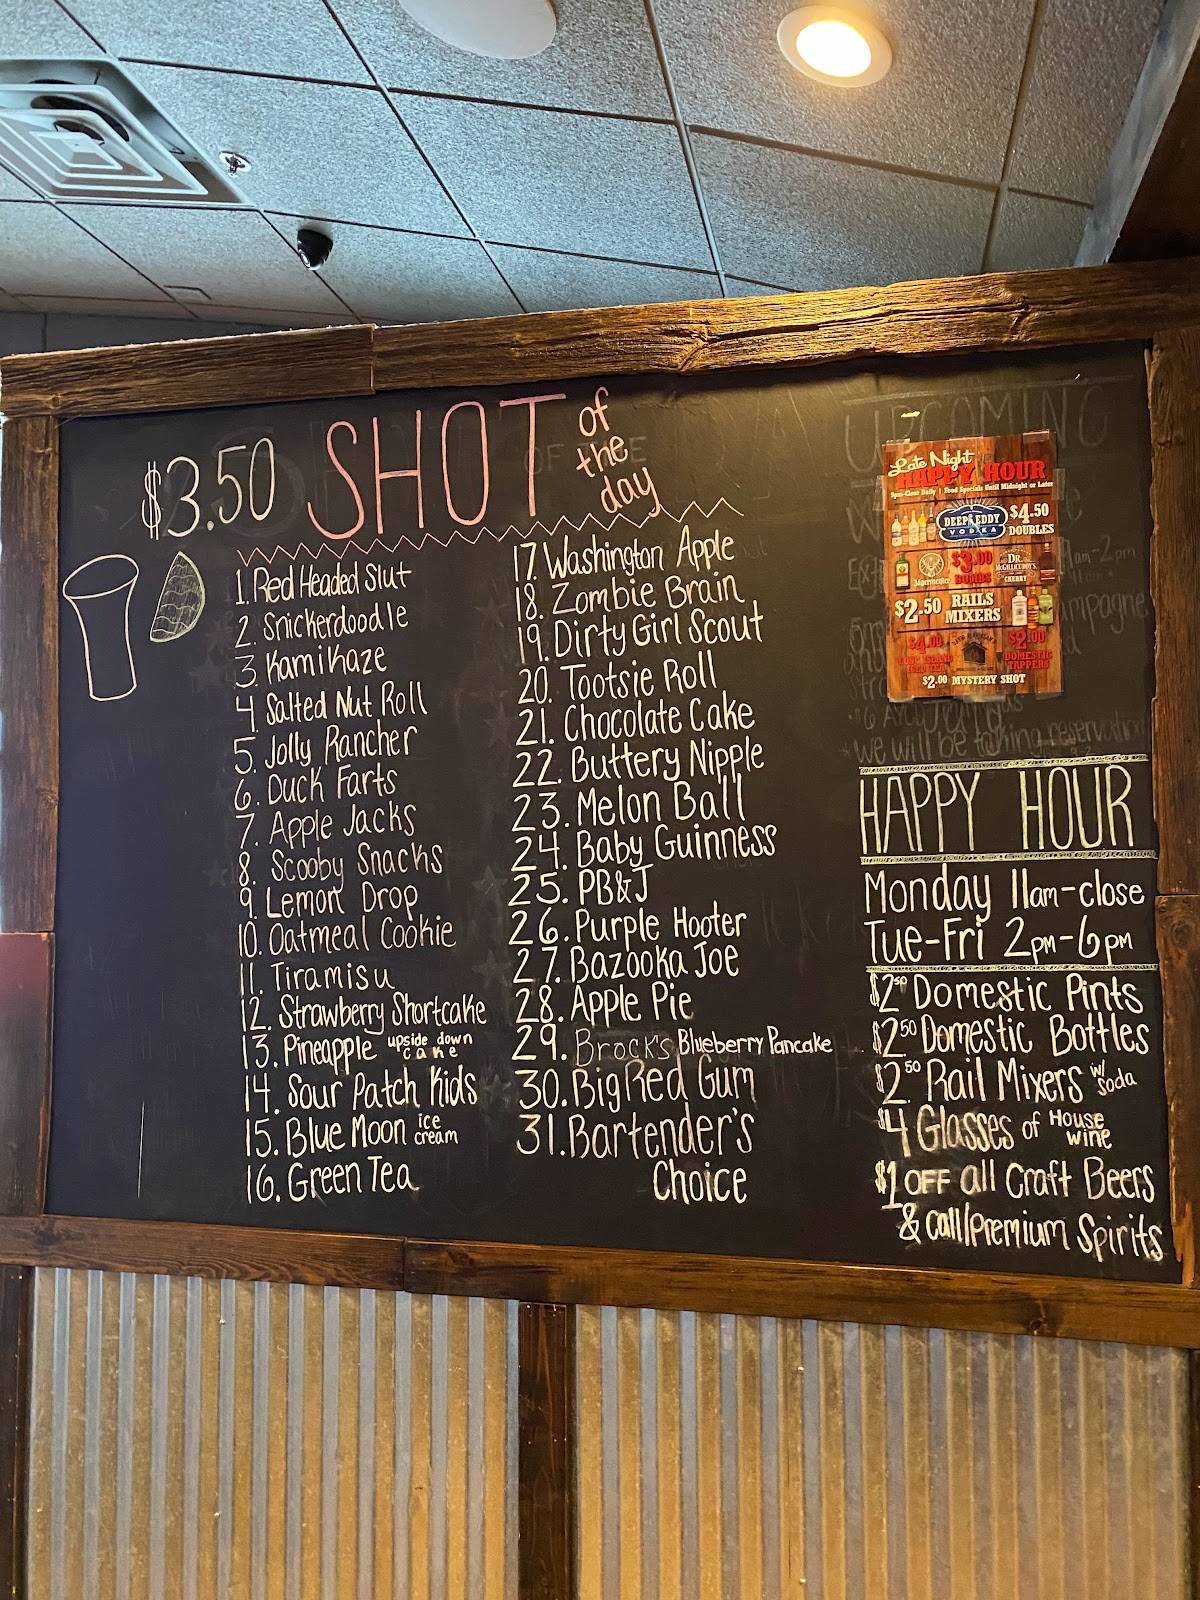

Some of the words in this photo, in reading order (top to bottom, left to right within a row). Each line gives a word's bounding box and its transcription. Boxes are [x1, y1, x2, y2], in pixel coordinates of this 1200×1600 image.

[579, 387, 610, 437] of
[142, 438, 274, 541] $3.50
[307, 393, 567, 540] SHOT
[576, 435, 628, 478] the
[888, 455, 929, 477] Late
[930, 450, 975, 471] Night
[897, 465, 975, 489] HAPPY
[983, 460, 1045, 482] HOUR
[600, 466, 661, 518] day
[1001, 481, 1028, 492] Midnight
[944, 515, 968, 527] DEEP
[975, 513, 1001, 526] EDDY
[949, 526, 998, 536] VODKA
[1008, 523, 1055, 536] DOUBLES
[1009, 502, 1050, 524] $4.50
[543, 534, 664, 577] Washington
[677, 524, 735, 571] Apple
[951, 550, 993, 574] $3.00
[253, 566, 295, 602] Red
[300, 561, 360, 598] Headed
[364, 561, 412, 591] Slut
[551, 576, 657, 615] Zombie
[664, 570, 745, 609] Brain
[951, 592, 995, 608] RAILS
[954, 572, 993, 585] BOMBS
[554, 614, 626, 658] Dirty
[632, 612, 682, 647] Girl
[688, 599, 764, 645] Scout
[894, 596, 942, 625] $2.50
[945, 607, 1002, 624] MIXERS
[1008, 629, 1047, 650] $2.00
[266, 644, 387, 684] Kamikaze
[559, 659, 654, 701] Tootsie
[663, 649, 717, 694] Roll
[922, 674, 948, 689] $2.00
[951, 674, 998, 686] MYSTERY
[1000, 673, 1026, 685] SHOT
[266, 690, 328, 726] Salted
[336, 685, 372, 718] Nut
[381, 680, 428, 717] Roll
[564, 698, 683, 742] Chocolate
[689, 690, 755, 732] Cake
[265, 731, 312, 770] Jolly
[325, 719, 418, 765] Rancher
[571, 741, 681, 782] Buttery
[690, 735, 765, 784] Nipple
[268, 766, 324, 806] Duck
[337, 762, 398, 799] Farts
[577, 784, 662, 827] Melon
[674, 772, 745, 821] Ball
[269, 809, 333, 850] Apple
[343, 800, 417, 837] Jacks
[860, 771, 980, 855] HAPPY
[1019, 764, 1134, 850] HOUR
[271, 846, 345, 894] Scooby
[357, 842, 443, 877] Snacks
[511, 830, 569, 872] 24.
[577, 829, 643, 868] Baby
[654, 823, 777, 861] Guinness
[266, 887, 345, 919] Lemon
[362, 881, 418, 922] Drop
[508, 871, 569, 907] 25.
[578, 864, 654, 906] PB&J
[864, 863, 991, 923] Monday
[1011, 867, 1146, 910] 11am-close
[269, 915, 370, 955] Oatmeal
[380, 914, 457, 949] Cookie
[508, 906, 570, 946] 26.
[575, 907, 660, 952] Purple
[673, 900, 747, 939] Hooter
[864, 915, 985, 965] Tue-Fri
[1003, 915, 1134, 966] 2pm-6pm
[270, 961, 395, 992] Tiramisu
[512, 946, 562, 984] 27.
[570, 945, 688, 984] Bazooka
[693, 940, 740, 978] Joe
[278, 993, 385, 1035] Strawberry
[391, 991, 487, 1027] Shortcake
[514, 983, 565, 1024] 28.
[570, 983, 642, 1028] Apple
[651, 981, 695, 1021] Pie
[912, 973, 1052, 1013] Domestic
[1066, 972, 1144, 1014] Pints
[283, 1033, 378, 1076] Pineapple
[387, 1033, 429, 1054] upside
[436, 1032, 474, 1046] down
[402, 1045, 459, 1061] cake
[511, 1024, 568, 1062] 29.
[575, 1027, 671, 1067] Brock's
[676, 1027, 764, 1056] Blueberry
[767, 1025, 834, 1055] Pancake
[921, 1013, 1033, 1056] Domestic
[1049, 1012, 1150, 1057] Bottles
[288, 1072, 343, 1110] Sour
[352, 1064, 421, 1111] Patch
[430, 1064, 479, 1109] Kids
[514, 1067, 568, 1110] 30.
[571, 1067, 621, 1113] Big
[624, 1051, 689, 1103] Red
[697, 1053, 757, 1105] Gum
[926, 1056, 986, 1103] Rail
[997, 1057, 1084, 1104] Mixers
[1089, 1059, 1106, 1078] w/
[1096, 1067, 1138, 1097] soda
[285, 1116, 346, 1159] Blue
[351, 1113, 407, 1148] Moon
[417, 1112, 441, 1131] ice
[414, 1128, 459, 1146] cream
[516, 1113, 566, 1157] 31.
[568, 1101, 756, 1159] Bartender's
[876, 1105, 912, 1159] $4
[916, 1103, 1015, 1152] Glasses
[1020, 1110, 1041, 1141] of
[1049, 1108, 1105, 1130] House
[1066, 1126, 1113, 1150] wine
[287, 1161, 362, 1203] Green
[367, 1155, 420, 1194] Tea
[653, 1157, 749, 1205] Choice
[875, 1159, 903, 1210] $1
[904, 1168, 951, 1196] OFF
[959, 1158, 997, 1196] all
[1005, 1158, 1073, 1200] Craft
[1083, 1155, 1156, 1204] Beers
[898, 1201, 922, 1246] &
[1077, 1211, 1165, 1263] Spirits
